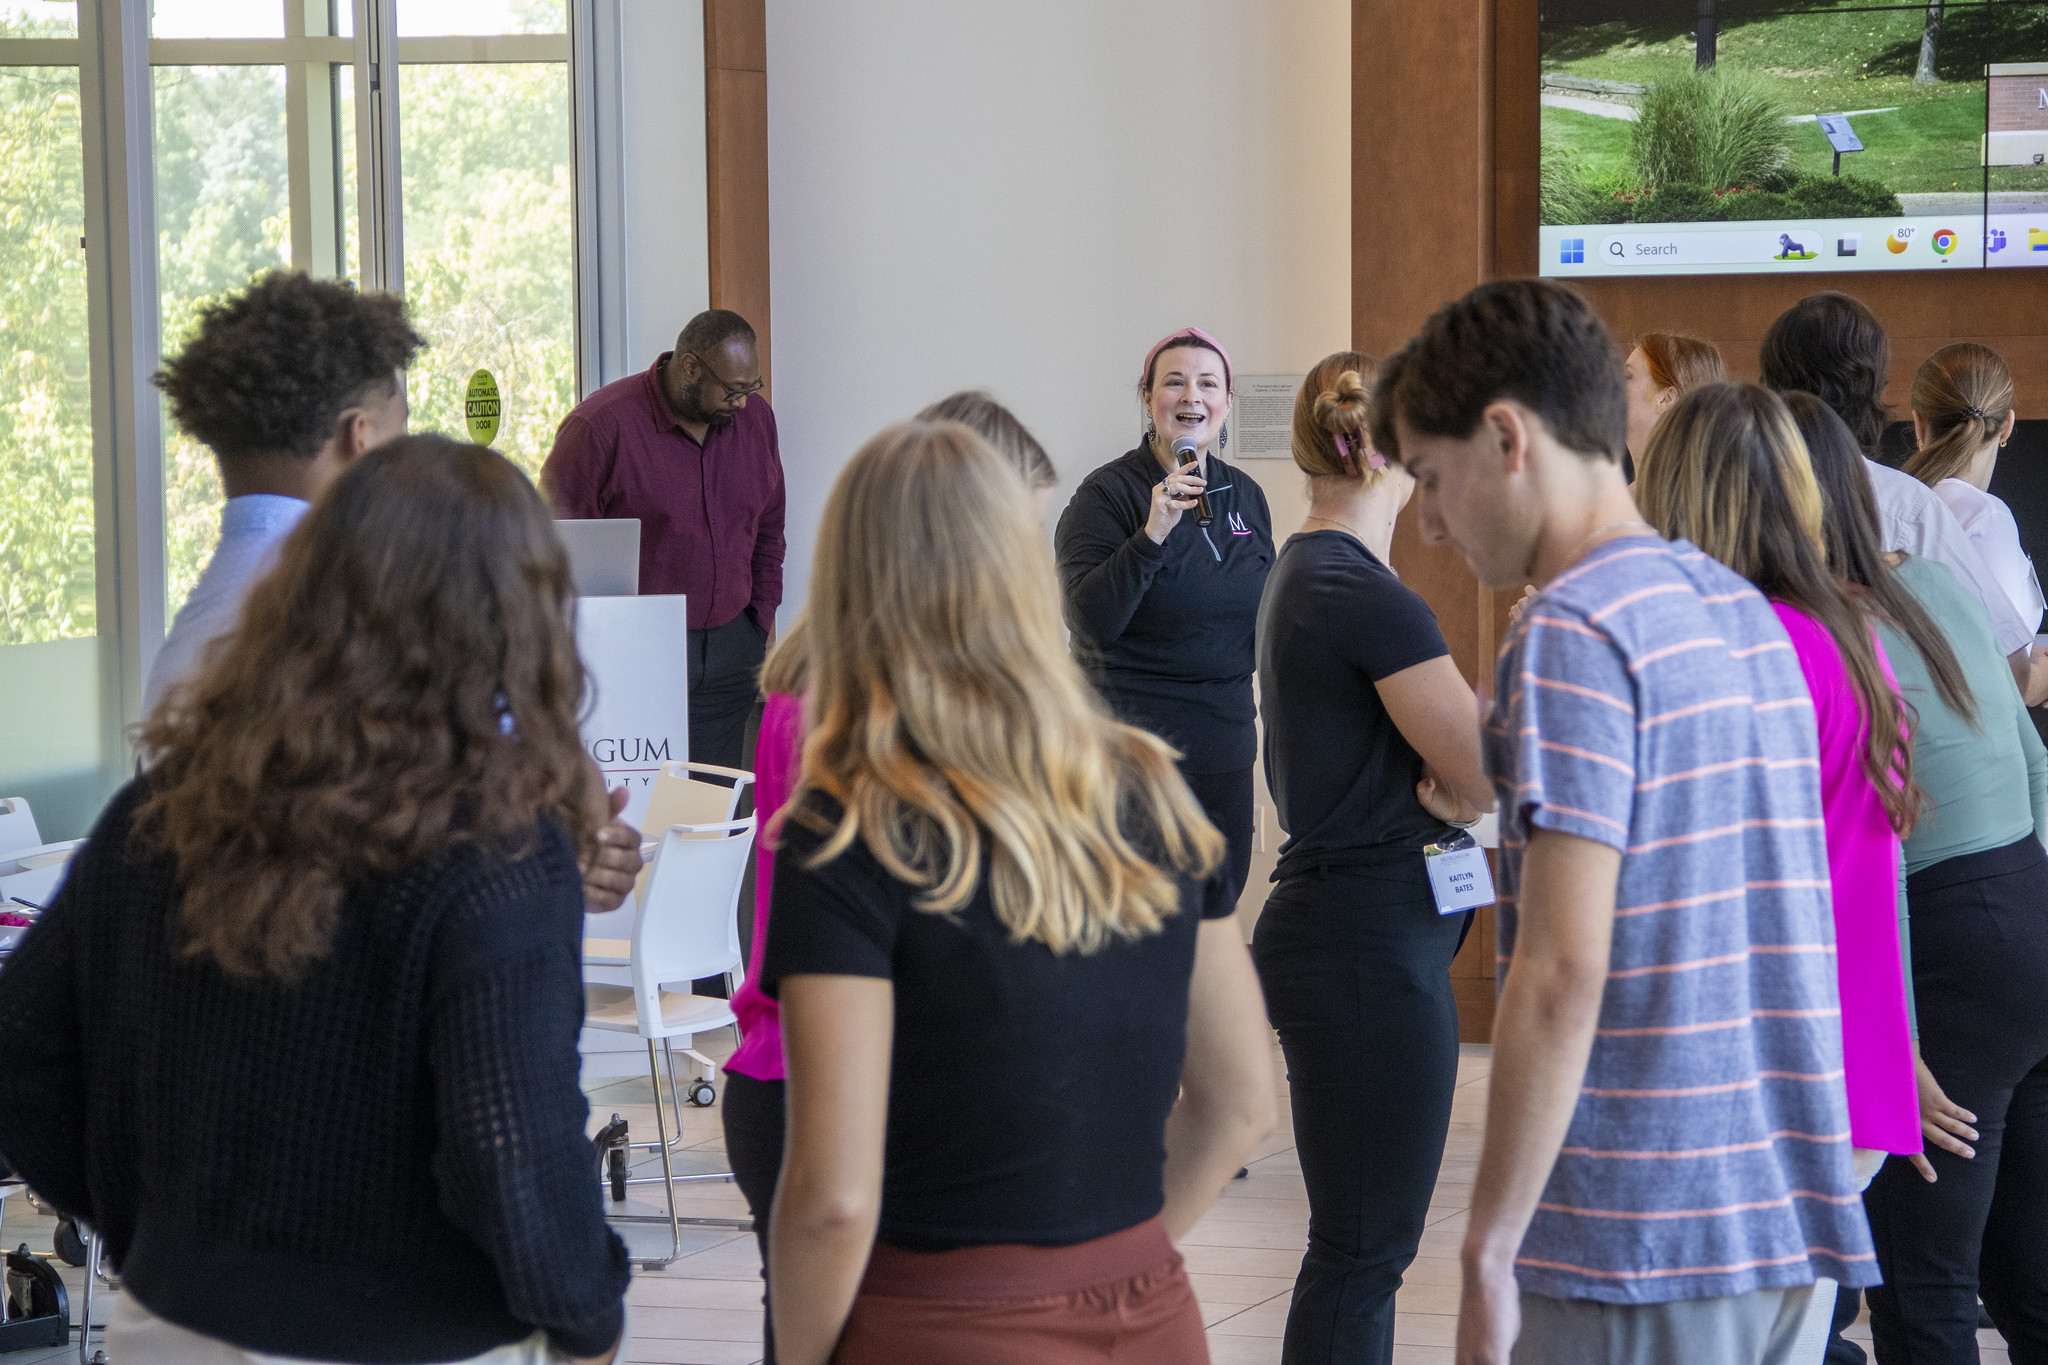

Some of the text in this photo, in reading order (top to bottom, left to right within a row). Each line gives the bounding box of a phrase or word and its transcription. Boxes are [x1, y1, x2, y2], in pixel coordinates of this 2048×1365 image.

[1635, 242, 1678, 256] Search
[468, 387, 497, 398] AUTOMATIC
[467, 401, 499, 416] CAUTION
[476, 420, 491, 430] DOOR
[1449, 872, 1474, 883] KAITLYN
[1455, 883, 1474, 894] BATES
